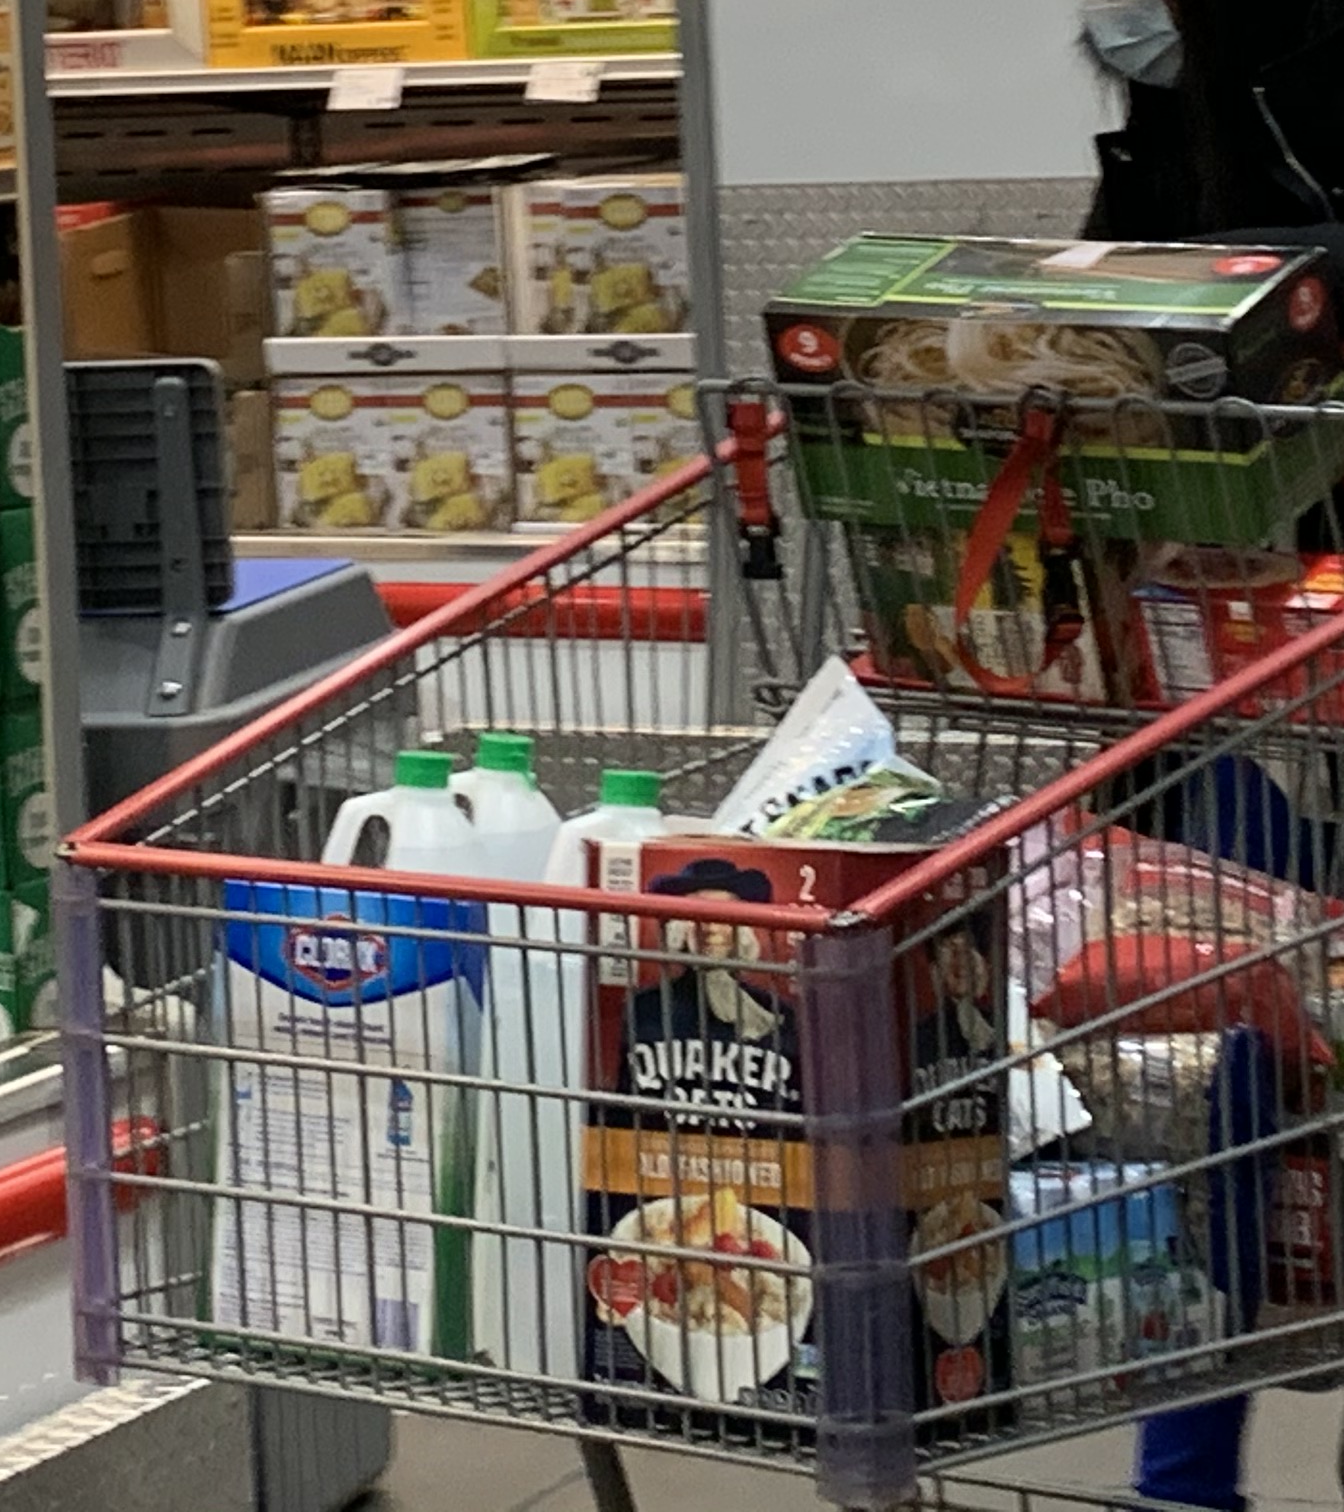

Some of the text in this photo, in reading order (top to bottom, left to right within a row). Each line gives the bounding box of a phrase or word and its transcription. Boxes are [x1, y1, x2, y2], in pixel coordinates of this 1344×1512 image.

[796, 330, 819, 352] 9
[1084, 478, 1156, 511] Pho
[799, 864, 817, 902] 2
[630, 1039, 794, 1100] QUAKER
